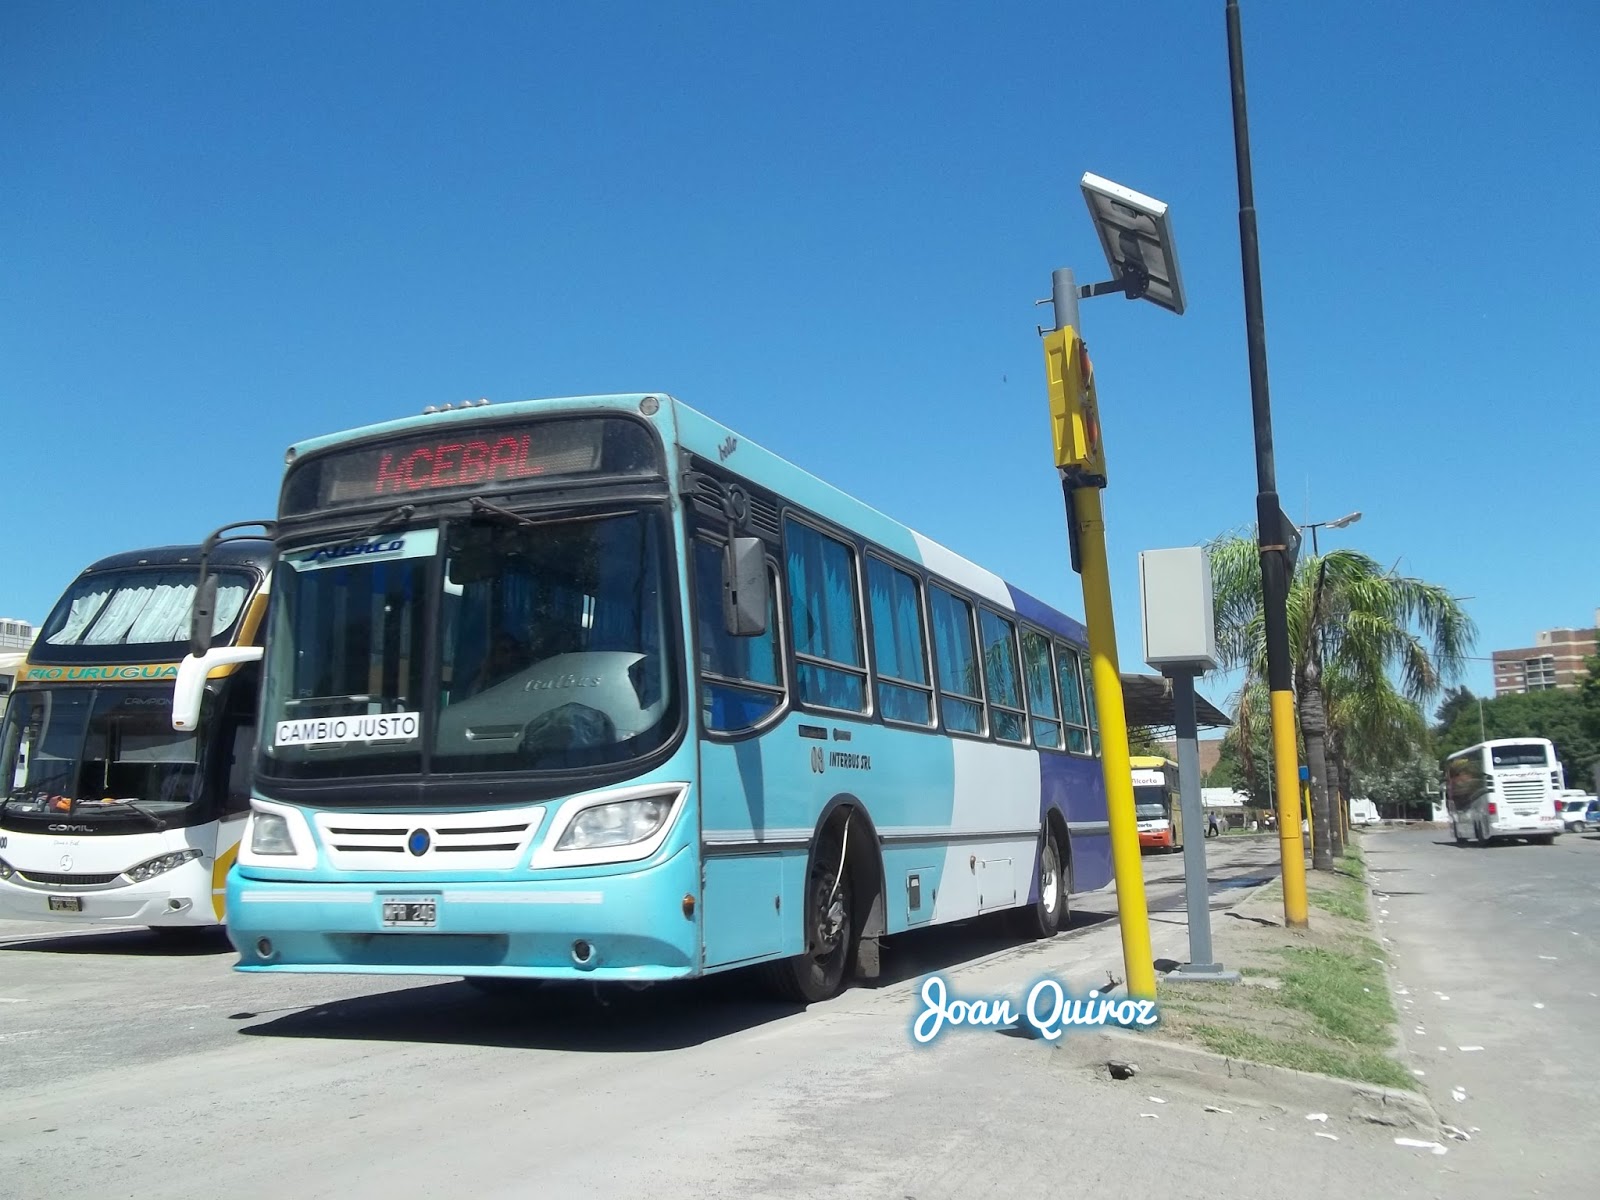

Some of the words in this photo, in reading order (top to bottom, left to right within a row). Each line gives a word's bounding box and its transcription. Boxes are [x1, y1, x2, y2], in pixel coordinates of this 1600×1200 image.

[27, 668, 64, 680] RIO
[67, 666, 178, 680] URUGUA
[124, 697, 172, 706] CAMPION
[279, 720, 347, 742] CAMBIO
[353, 717, 416, 738] JUSTO
[829, 752, 860, 769] INTERBUS
[860, 755, 872, 771] SRL
[48, 824, 94, 832] COMIL
